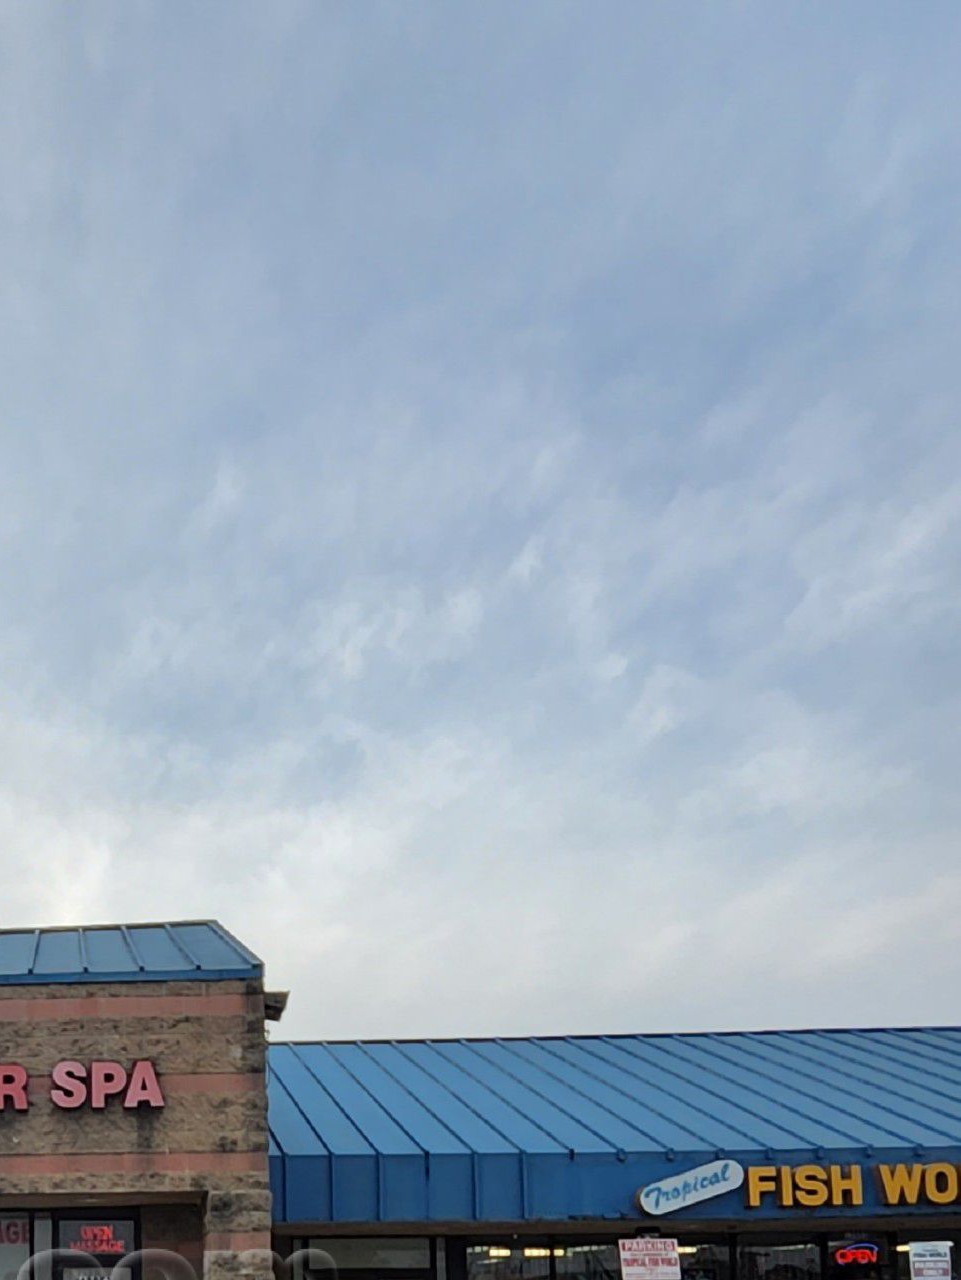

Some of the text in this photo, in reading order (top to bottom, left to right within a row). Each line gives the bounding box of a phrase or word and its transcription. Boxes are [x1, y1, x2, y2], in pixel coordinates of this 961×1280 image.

[49, 1060, 166, 1109] SPA
[643, 1162, 731, 1210] Tropical
[747, 1164, 863, 1207] FISH
[80, 1225, 113, 1240] OPEN
[622, 1241, 676, 1251] PARKING
[835, 1249, 877, 1264] OPEN
